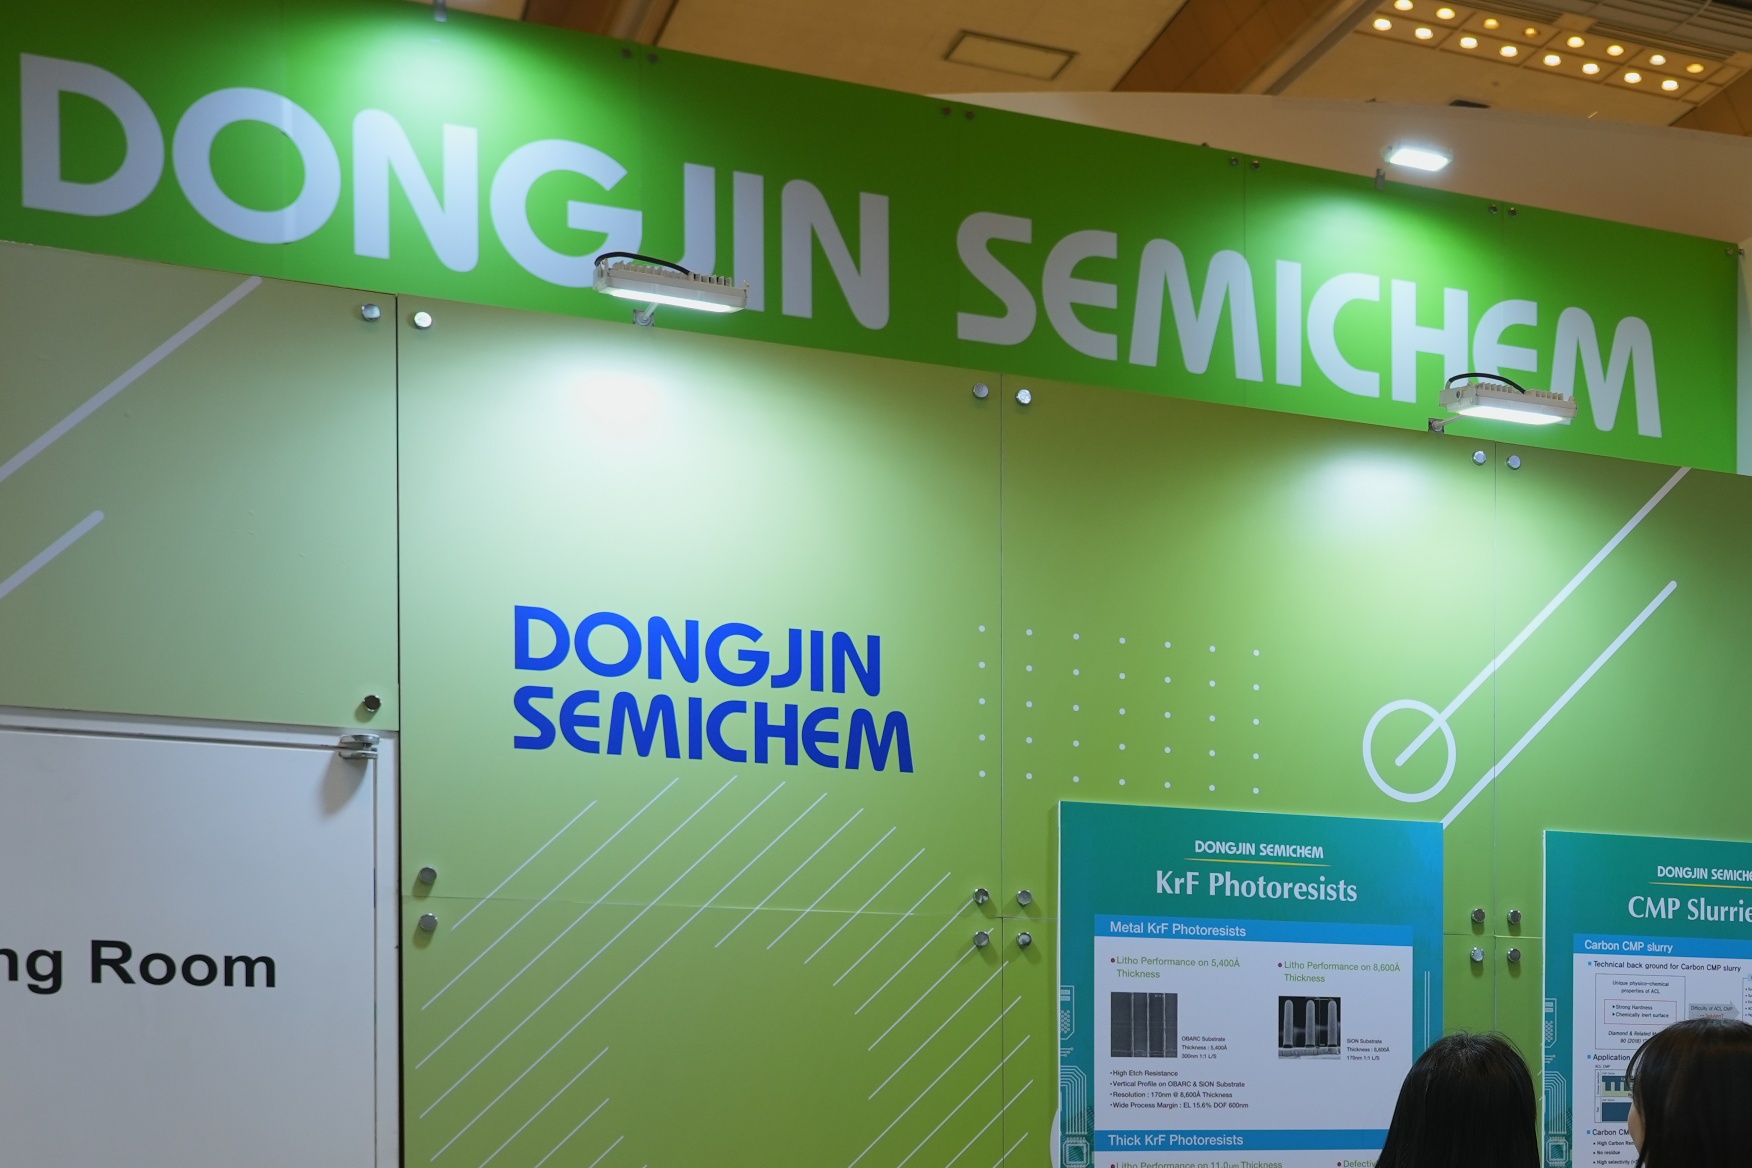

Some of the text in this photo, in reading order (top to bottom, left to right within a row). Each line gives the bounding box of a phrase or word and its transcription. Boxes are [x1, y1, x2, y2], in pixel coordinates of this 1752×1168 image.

[20, 51, 1663, 439] DONGJIN SEMICHEM
[514, 605, 880, 697] DONGJIN
[514, 685, 914, 773] SEMICHEM
[1195, 840, 1324, 859] DONGJIN SEMICHEM
[1657, 866, 1708, 880] DONGJIN
[1156, 870, 1358, 902] KrF Photoresists
[1628, 896, 1680, 919] CMP
[1110, 921, 1246, 938] Metal KrF Photoresists
[1584, 940, 1673, 954] Carbon CMP slurry
[91, 940, 276, 988] Room
[1117, 956, 1138, 965] Litho
[1141, 957, 1195, 967] Performance
[1198, 959, 1209, 967] on
[1284, 960, 1305, 970] Litho
[1307, 962, 1359, 972] Performance
[1361, 964, 1371, 972] on
[1645, 963, 1668, 971] ground
[1117, 969, 1160, 979] Thickness
[1284, 973, 1326, 983] Thickness
[1108, 1134, 1244, 1146] Thick KrF Photoresists
[1241, 1161, 1283, 1168] Thickness
